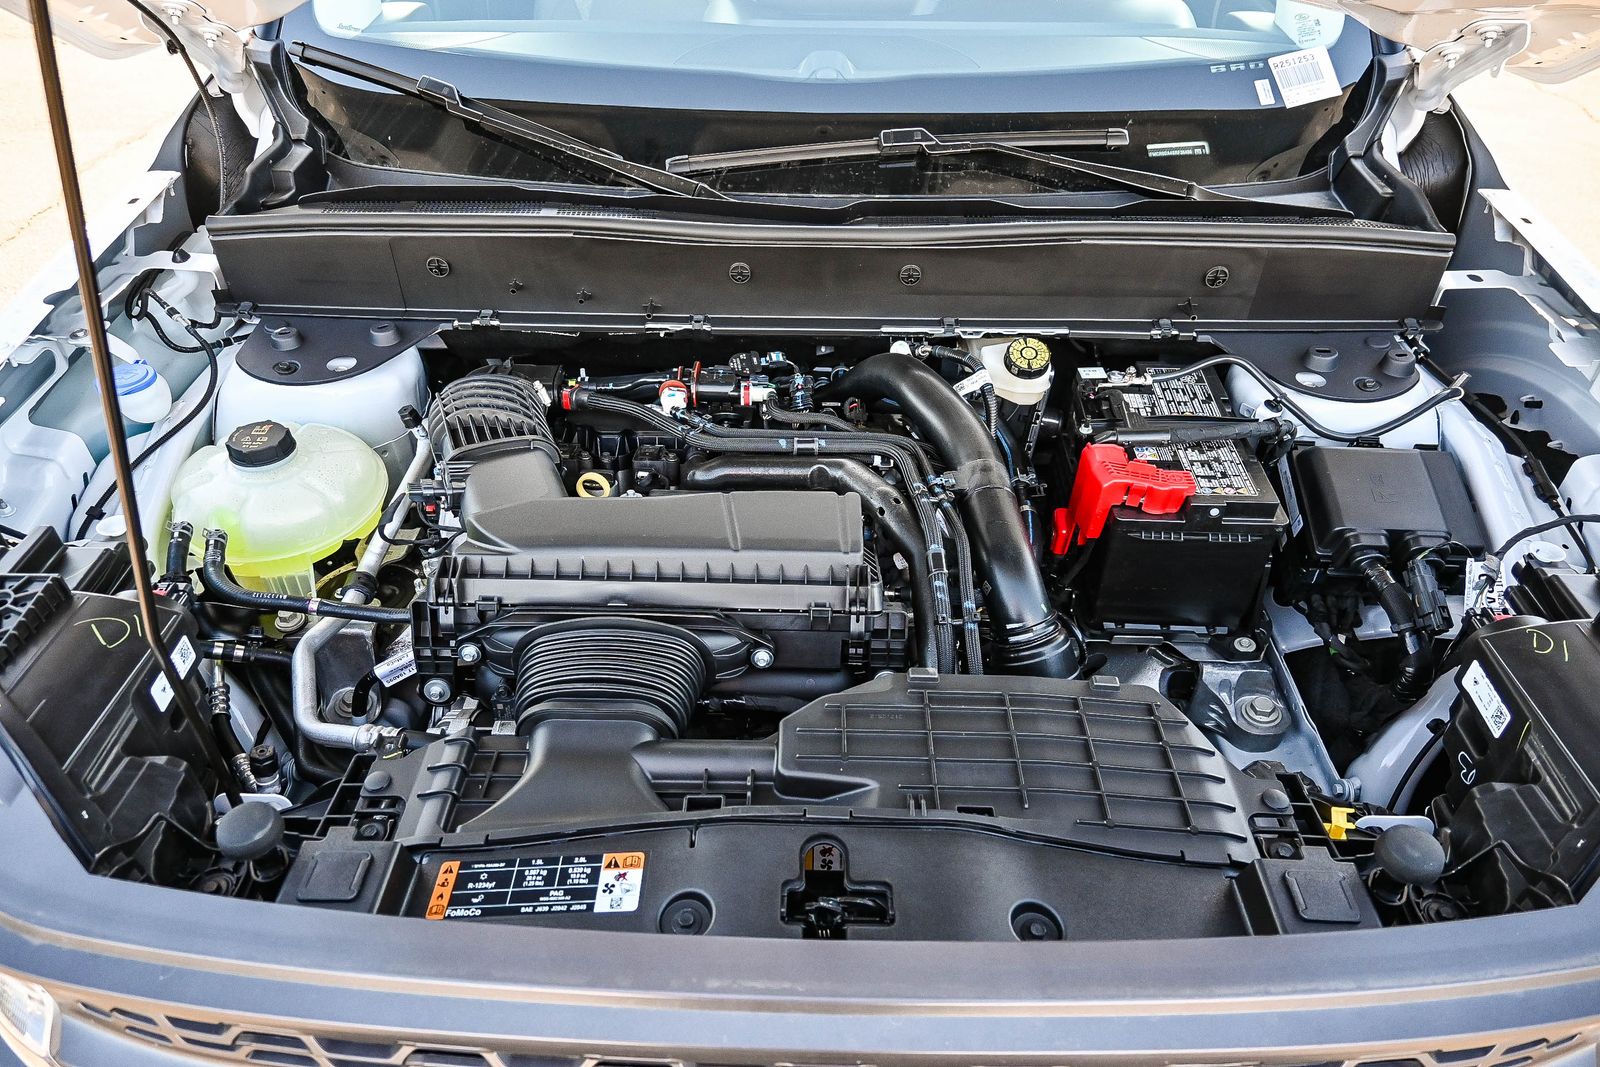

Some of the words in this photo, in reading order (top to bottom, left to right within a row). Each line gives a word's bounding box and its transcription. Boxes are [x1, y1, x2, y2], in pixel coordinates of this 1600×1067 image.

[1273, 54, 1315, 70] R251253
[467, 881, 496, 890] R-1234yf
[445, 908, 482, 918] FoMoCo
